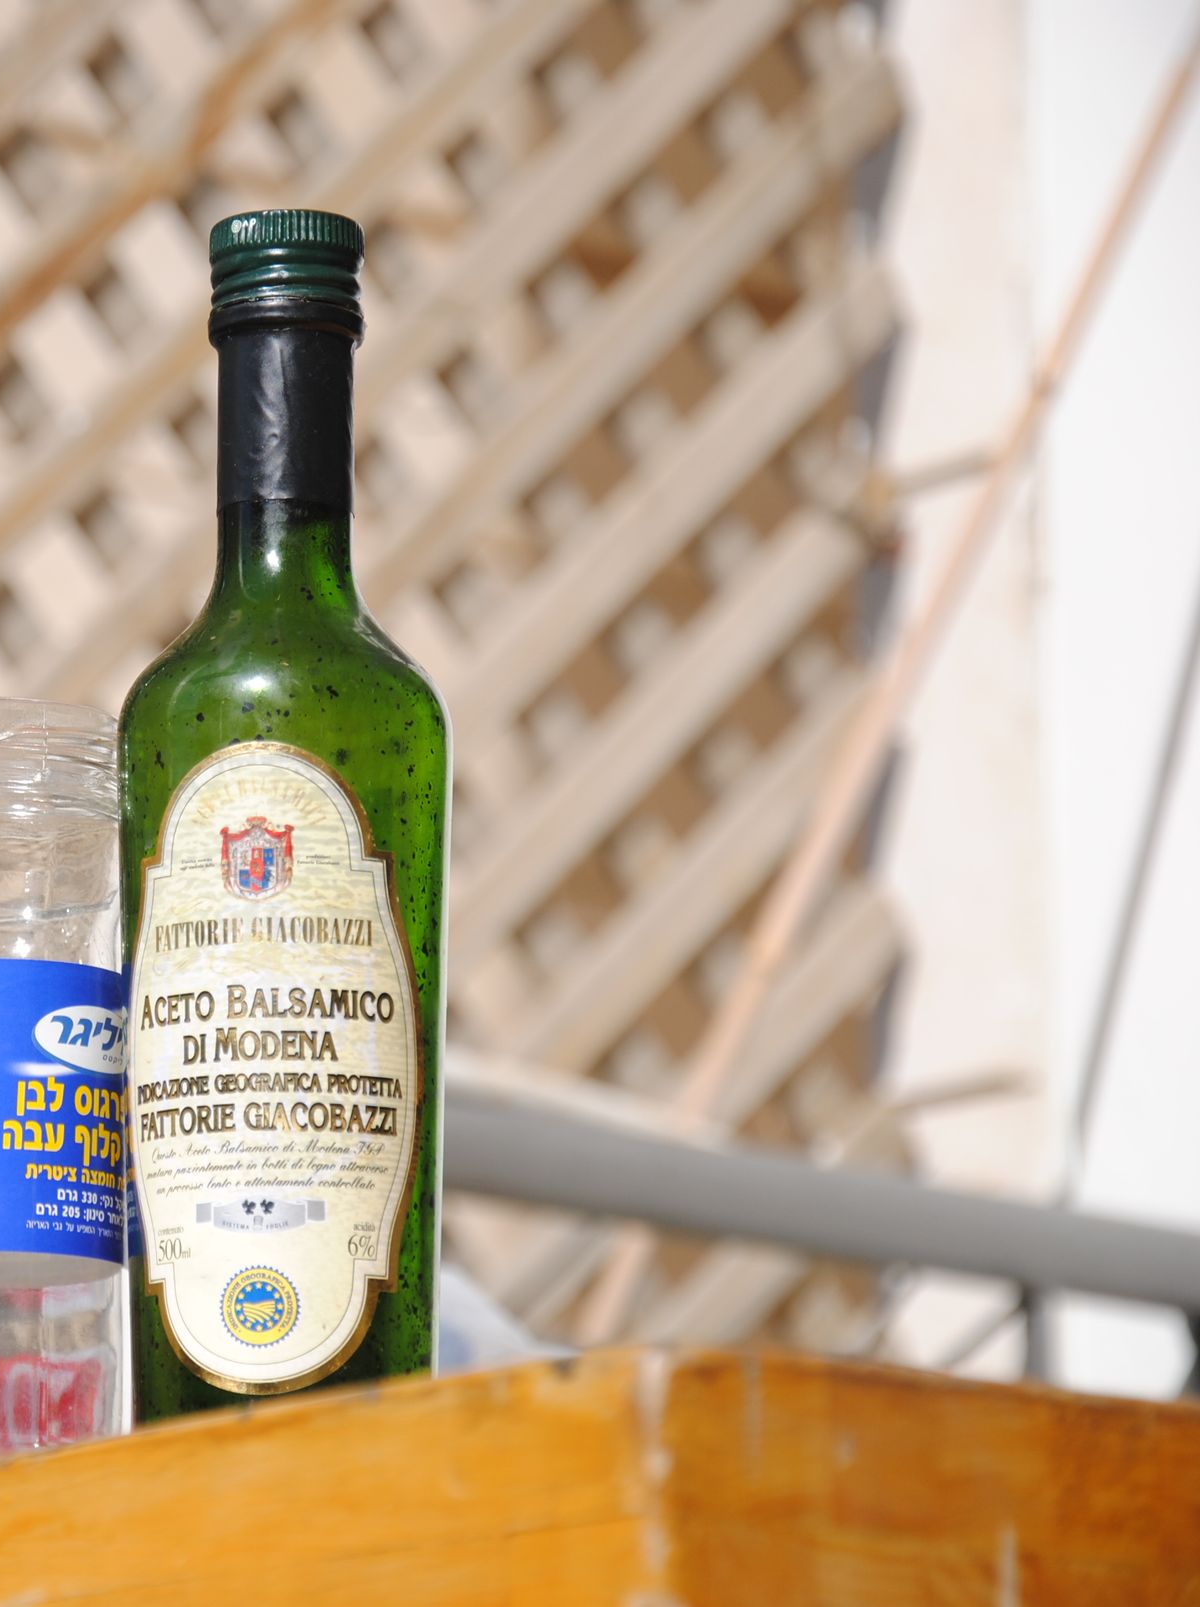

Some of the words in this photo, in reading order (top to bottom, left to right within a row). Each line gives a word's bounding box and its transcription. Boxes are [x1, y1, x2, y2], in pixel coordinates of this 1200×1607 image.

[155, 918, 243, 952] FATTORIE
[251, 916, 373, 947] GIACOBAZZI
[141, 990, 215, 1031] ACETO
[227, 985, 394, 1025] BALSAMICO
[183, 1034, 207, 1065] DI
[214, 1027, 338, 1062] MODENA
[16, 1076, 64, 1116] לבן
[215, 1073, 322, 1094] GEOGRAFICA
[327, 1074, 402, 1099] PROTETTA
[141, 1104, 236, 1143] FATTORIE
[244, 1102, 397, 1136] GIACOBAZZI
[2, 1120, 64, 1152] עבה
[75, 1122, 121, 1167] קלוף
[215, 1140, 279, 1155] Balsamico
[282, 1141, 296, 1152] di
[298, 1140, 350, 1154] Modena
[25, 1163, 77, 1182] ציטרית
[246, 1162, 257, 1170] in
[291, 1158, 304, 1169] di
[81, 1168, 115, 1189] חומצה
[57, 1188, 78, 1202] גרם
[81, 1191, 97, 1204] 330
[35, 1202, 58, 1216] גרם
[62, 1205, 80, 1218] 205
[347, 1233, 375, 1257] 6%
